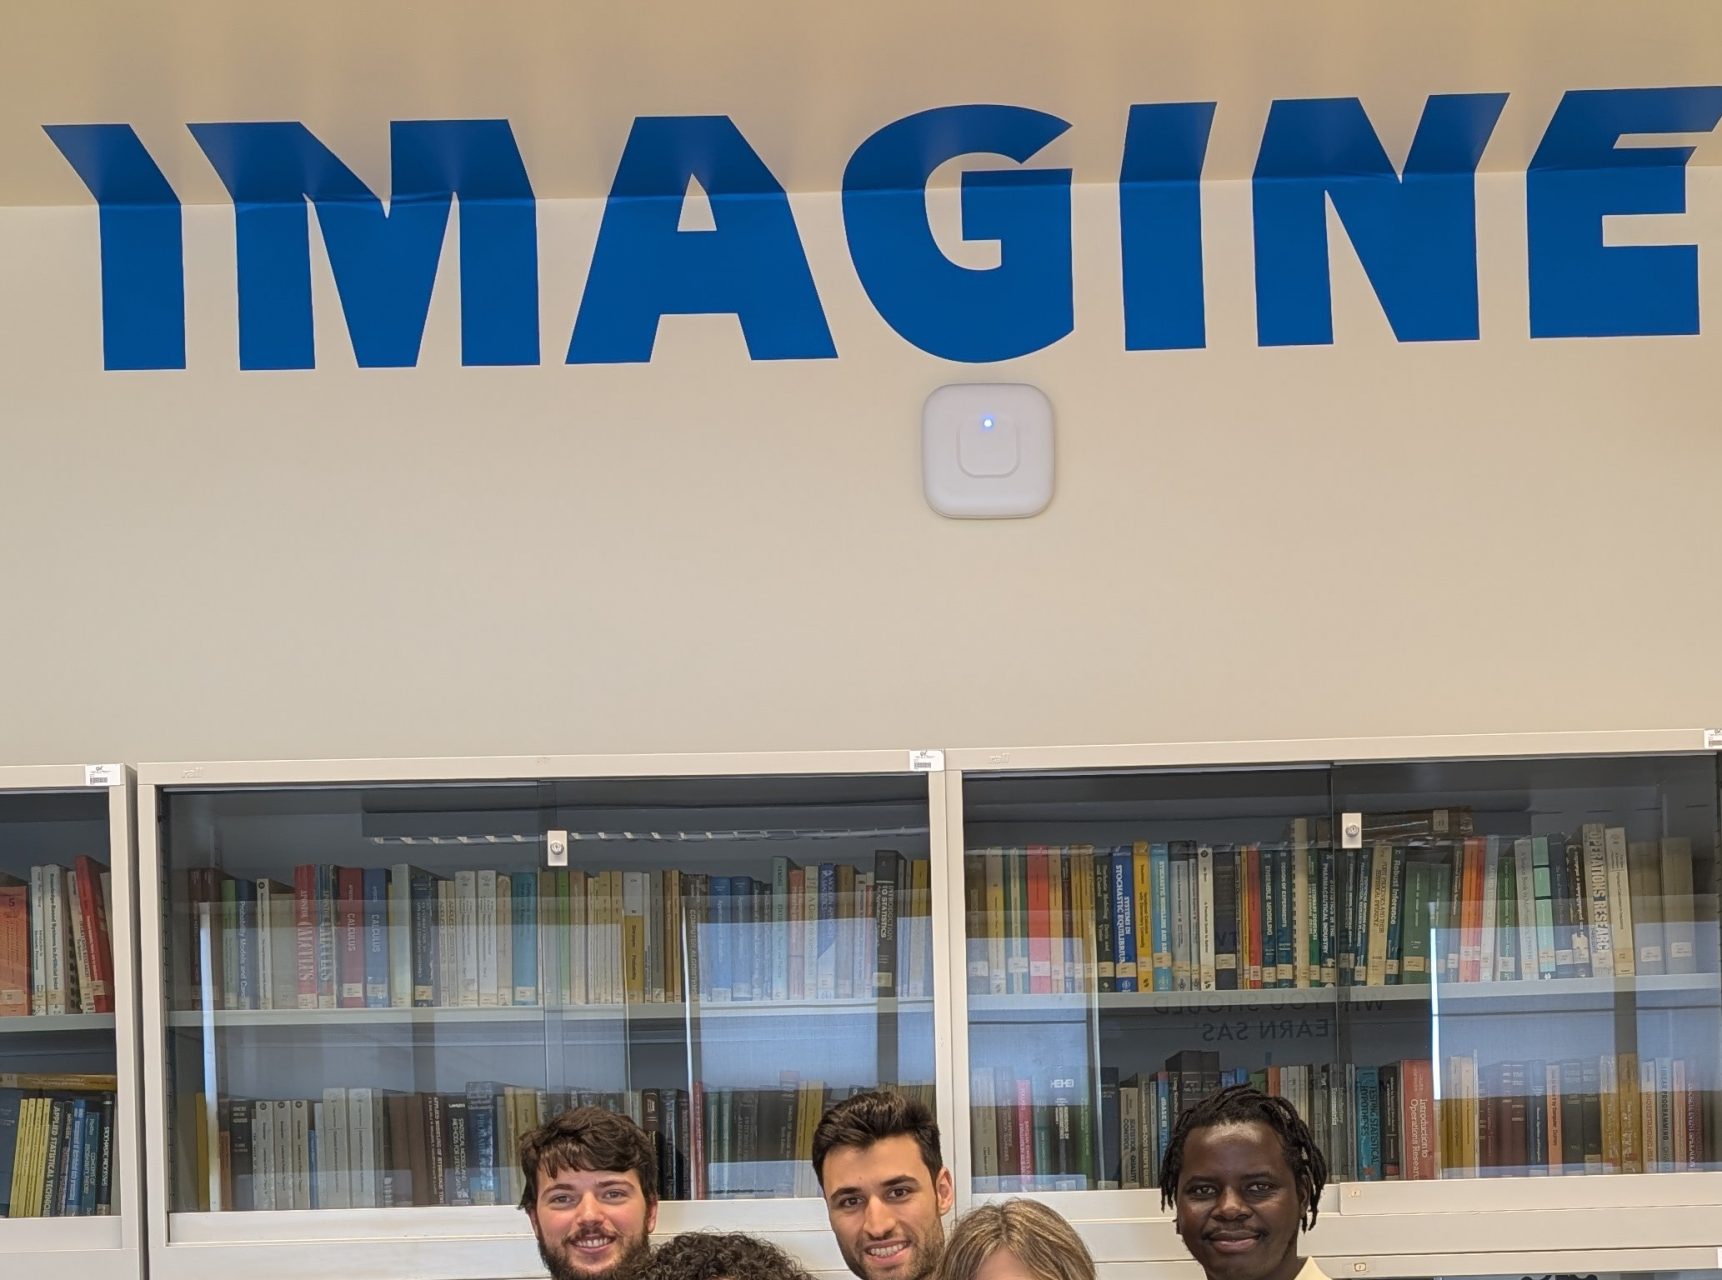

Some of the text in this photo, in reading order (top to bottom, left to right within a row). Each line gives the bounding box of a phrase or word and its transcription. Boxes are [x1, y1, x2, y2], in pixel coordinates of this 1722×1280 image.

[42, 86, 1722, 371] IMAGINE
[1115, 864, 1123, 913] STOCHASTIC
[1281, 882, 1286, 890] OF
[1589, 832, 1606, 897] OPERATIONS
[1391, 889, 1399, 924] Inference
[347, 913, 356, 952] CALCULUS
[371, 914, 380, 952] CALCULUS
[51, 1105, 61, 1135] APPLIED
[1360, 1085, 1368, 1136] HYPOTHESES
[1369, 1086, 1379, 1165] TESTING STATISTICAL
[1419, 1099, 1428, 1158] Introduction to
[1661, 1091, 1669, 1140] PROGRAMMING
[47, 1137, 58, 1178] STATISTICAL
[1409, 1099, 1420, 1180] Operations Researc
